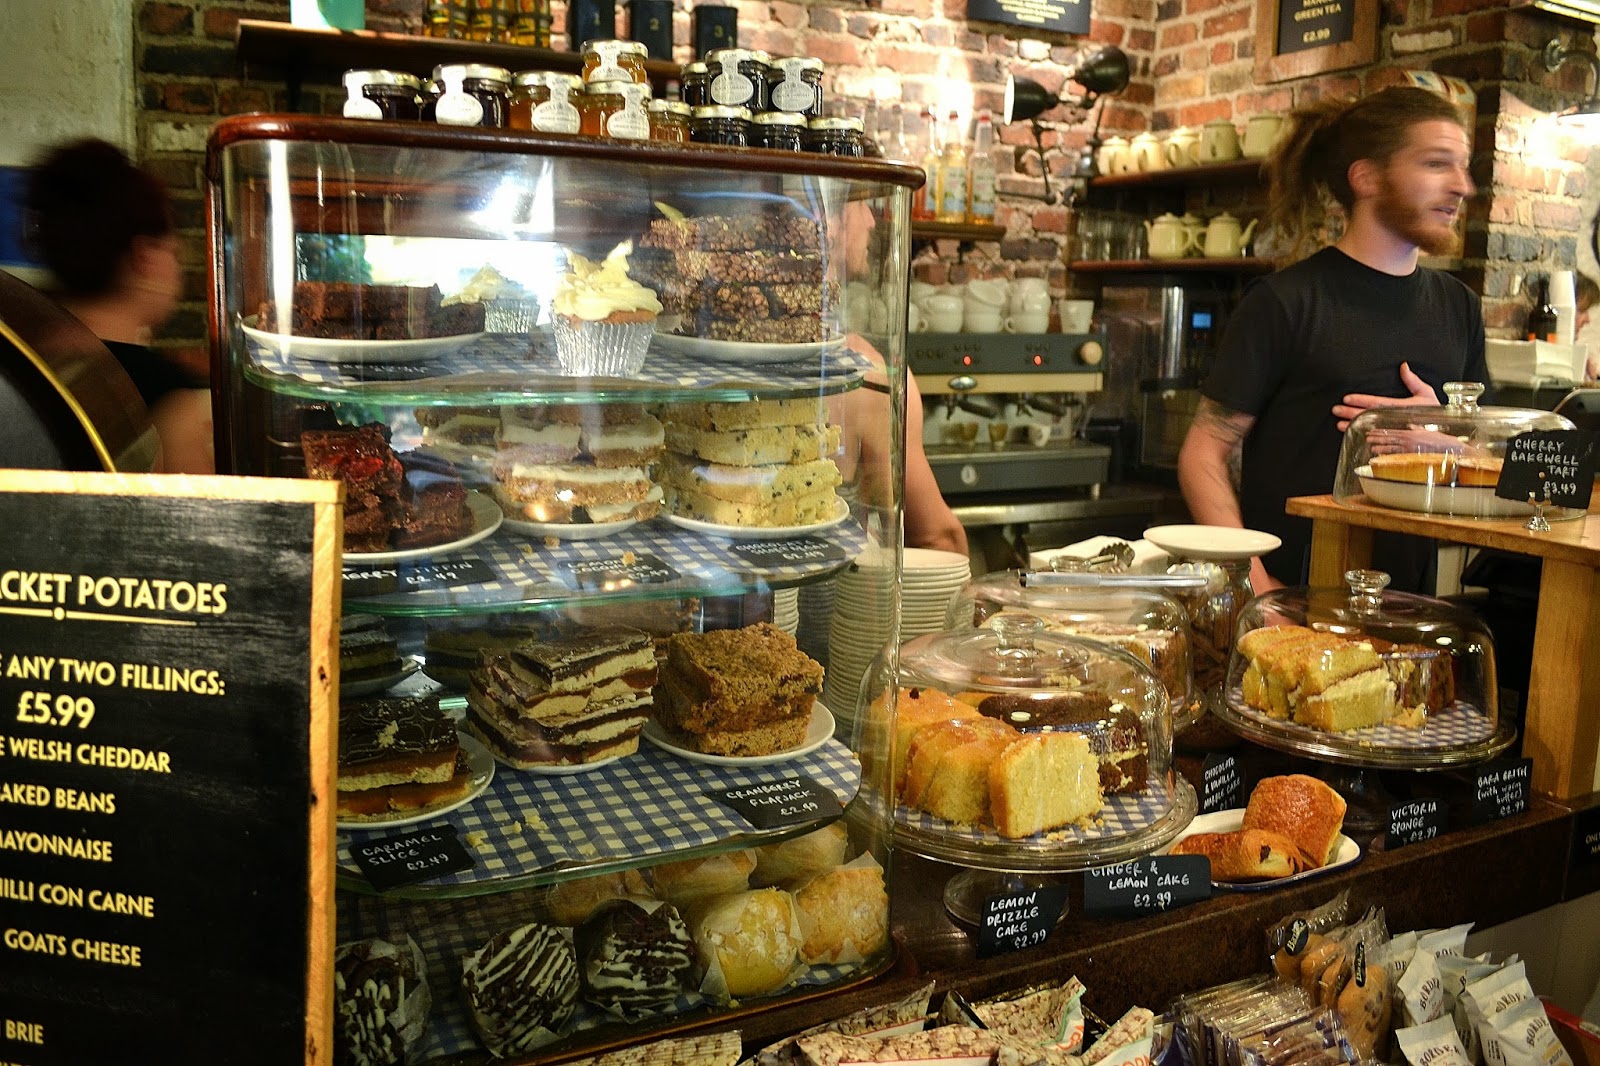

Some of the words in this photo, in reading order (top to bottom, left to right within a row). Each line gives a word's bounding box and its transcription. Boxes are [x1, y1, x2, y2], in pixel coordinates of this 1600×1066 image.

[1294, 7, 1324, 22] GREEN
[1325, 3, 1341, 14] TEA
[1514, 438, 1564, 453] CHERRY
[1511, 450, 1579, 466] BAKEWELL
[1547, 464, 1578, 478] TART
[1543, 481, 1577, 496] £3.49
[0, 571, 72, 604] CKET
[78, 575, 228, 614] POTATOES
[7, 654, 55, 680] ANY
[59, 657, 116, 686] TWO
[121, 663, 226, 696] FILLINGS:
[16, 690, 96, 729] £5.99
[9, 736, 72, 763] WELSH
[76, 743, 172, 774] CHEDDAR
[1204, 756, 1235, 781] CHOCOLATE
[1477, 772, 1500, 789] BARA
[1502, 765, 1527, 782] BRITH
[726, 780, 801, 799] CRANBERRY
[1211, 769, 1235, 791] VANILLA
[1227, 776, 1240, 795] CAKE
[0, 782, 50, 807] AKED
[55, 787, 116, 814] BEANS
[749, 790, 811, 807] FLAPJACK
[1391, 801, 1437, 821] VICTORIA
[1391, 816, 1424, 835] SPONGE
[1409, 825, 1437, 842] £2.99
[362, 834, 442, 856] CARAMEL
[368, 848, 419, 866] SLICE
[406, 853, 449, 871] £2.49
[1091, 862, 1142, 878] GINGER
[1150, 860, 1158, 875] &
[1109, 875, 1149, 890] LEMON
[1157, 873, 1190, 887] CAKE
[39, 883, 83, 907] CON
[88, 889, 155, 918] CARNE
[990, 891, 1037, 912] LEMON
[1133, 891, 1172, 909] £2.99
[987, 906, 1039, 927] DRIZZLE
[996, 921, 1028, 939] CAKE
[1014, 928, 1047, 949] £2.99
[4, 928, 67, 956] GOATS
[71, 938, 142, 967] CHEESE
[5, 1019, 44, 1044] BRIE
